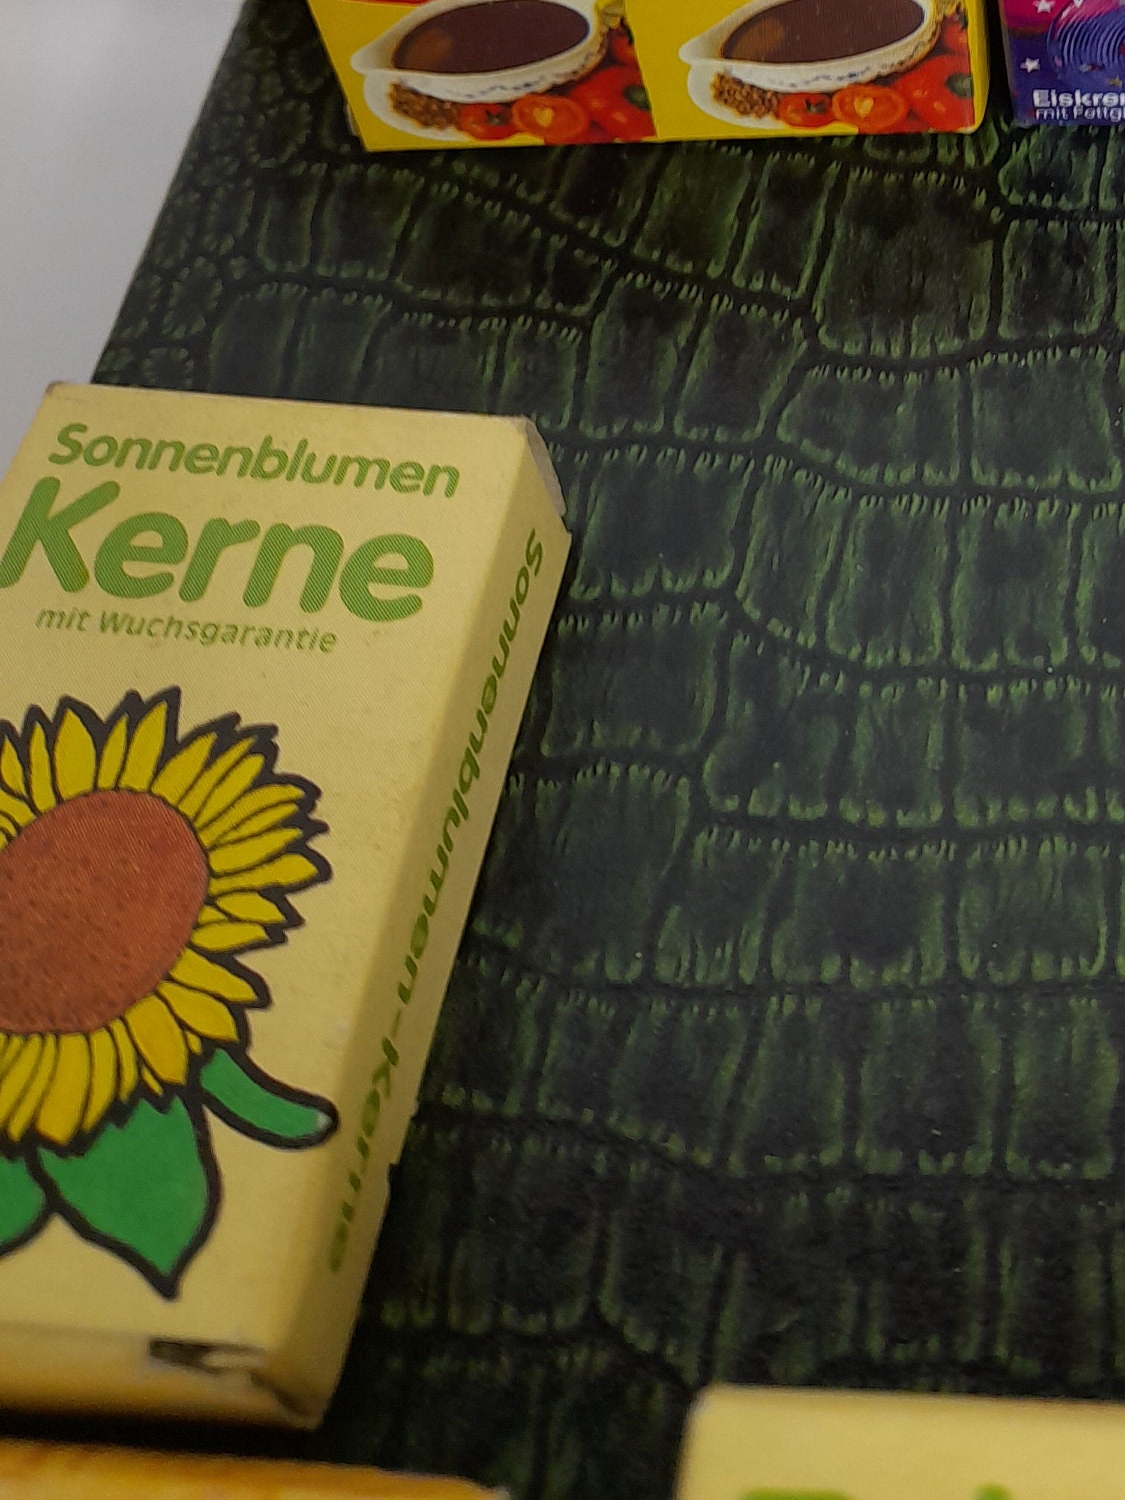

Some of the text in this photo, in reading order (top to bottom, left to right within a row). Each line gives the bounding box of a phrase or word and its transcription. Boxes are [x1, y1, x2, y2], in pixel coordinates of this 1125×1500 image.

[1035, 106, 1069, 121] mit
[48, 422, 461, 499] Sonnenblumen
[0, 476, 436, 623] Kerne
[35, 606, 338, 654] mit Wuchsgarantie
